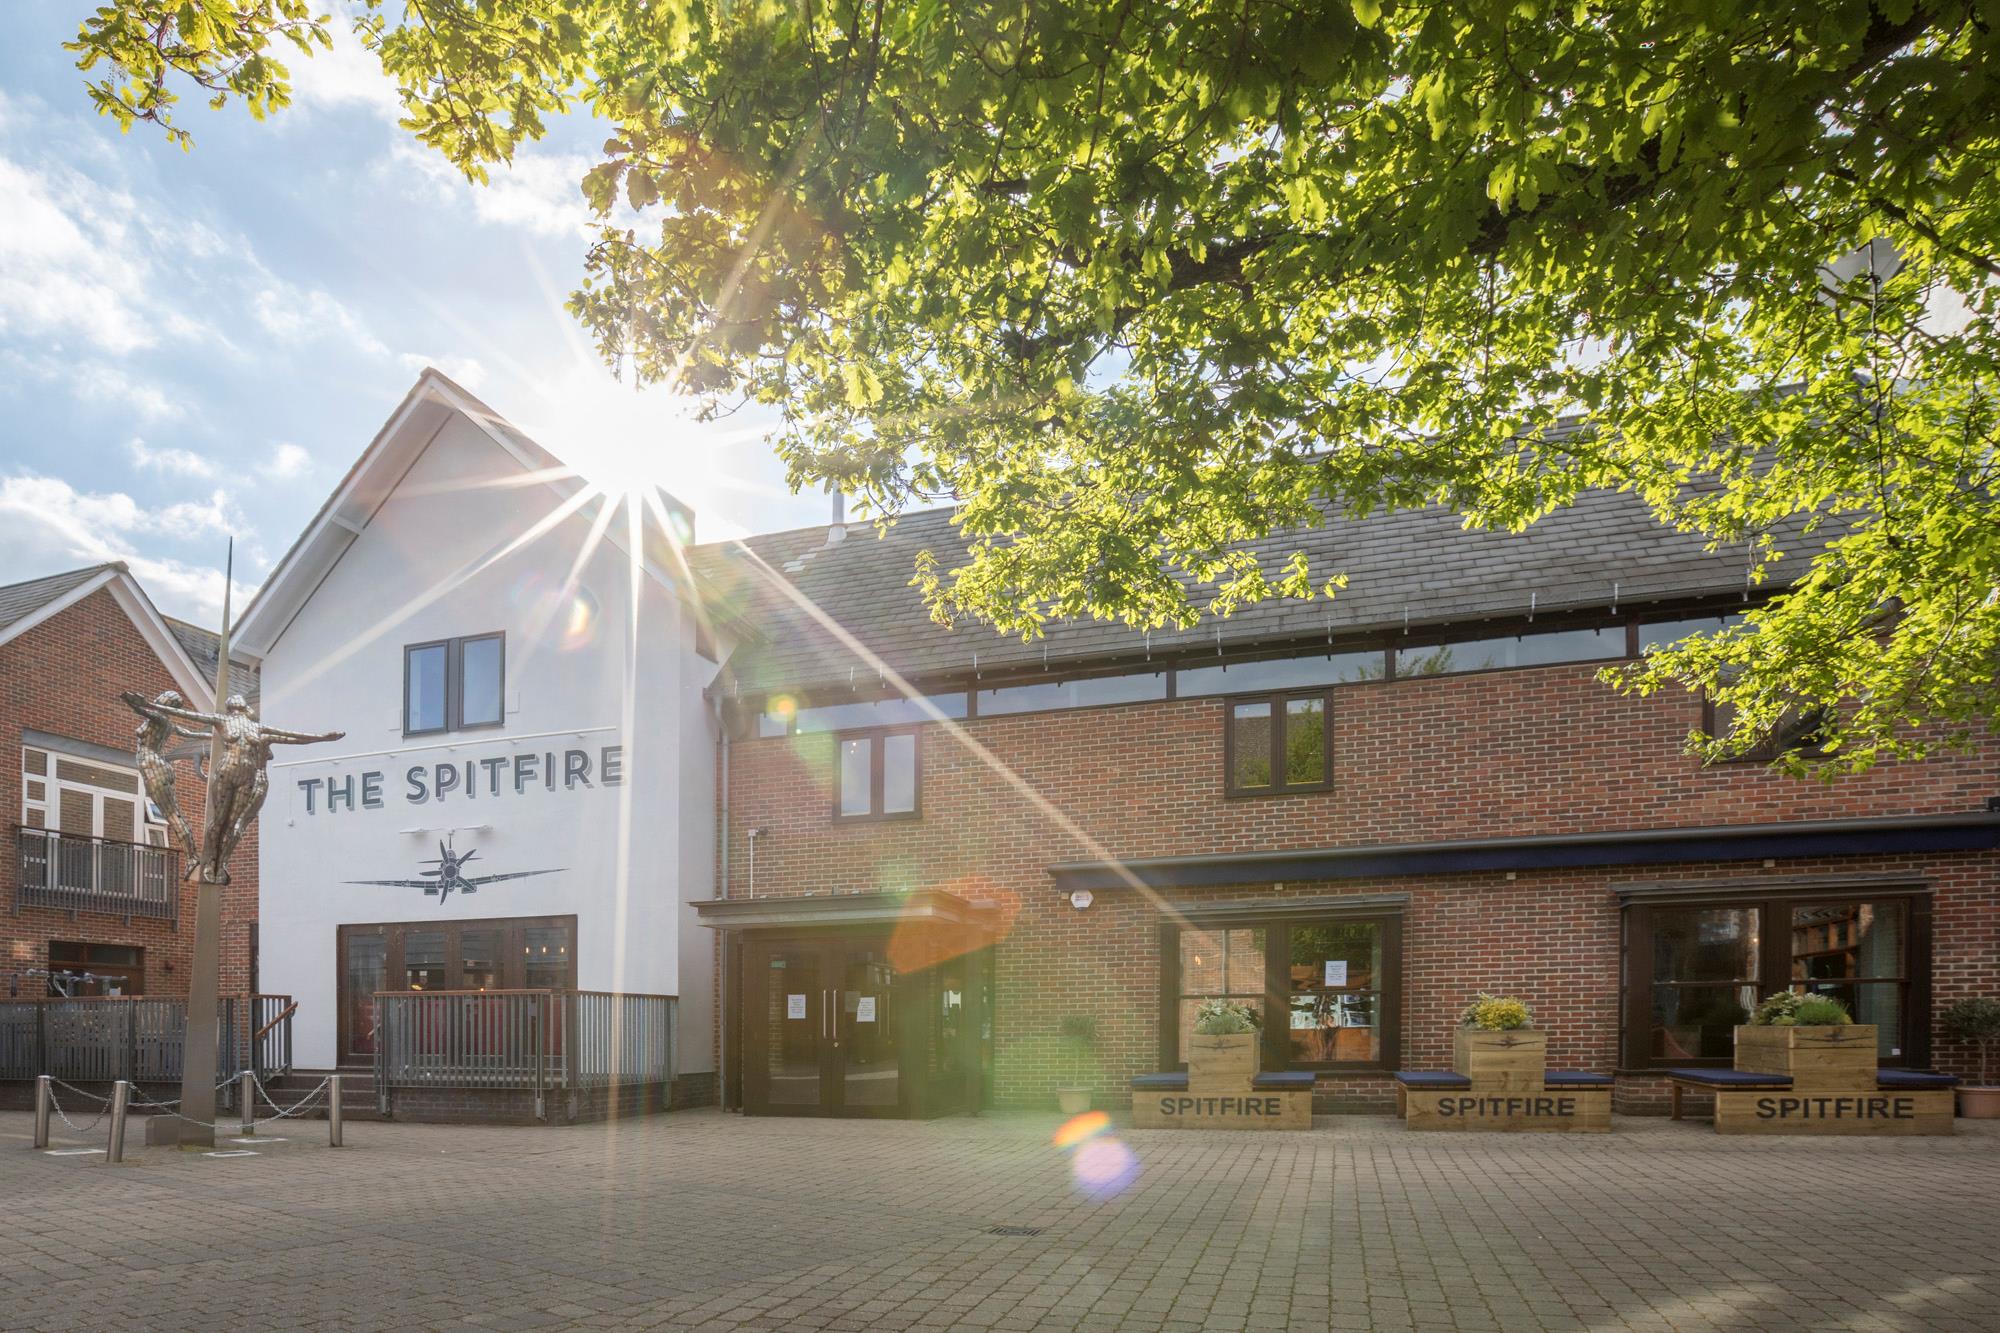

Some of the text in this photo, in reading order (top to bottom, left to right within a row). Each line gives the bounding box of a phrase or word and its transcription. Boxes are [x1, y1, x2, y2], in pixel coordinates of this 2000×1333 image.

[298, 745, 626, 816] THE SPITFIRE
[1160, 1097, 1281, 1116] SPITFIRE
[1437, 1097, 1577, 1117] SPITFIRE
[1755, 1097, 1915, 1119] SPITFIRE
